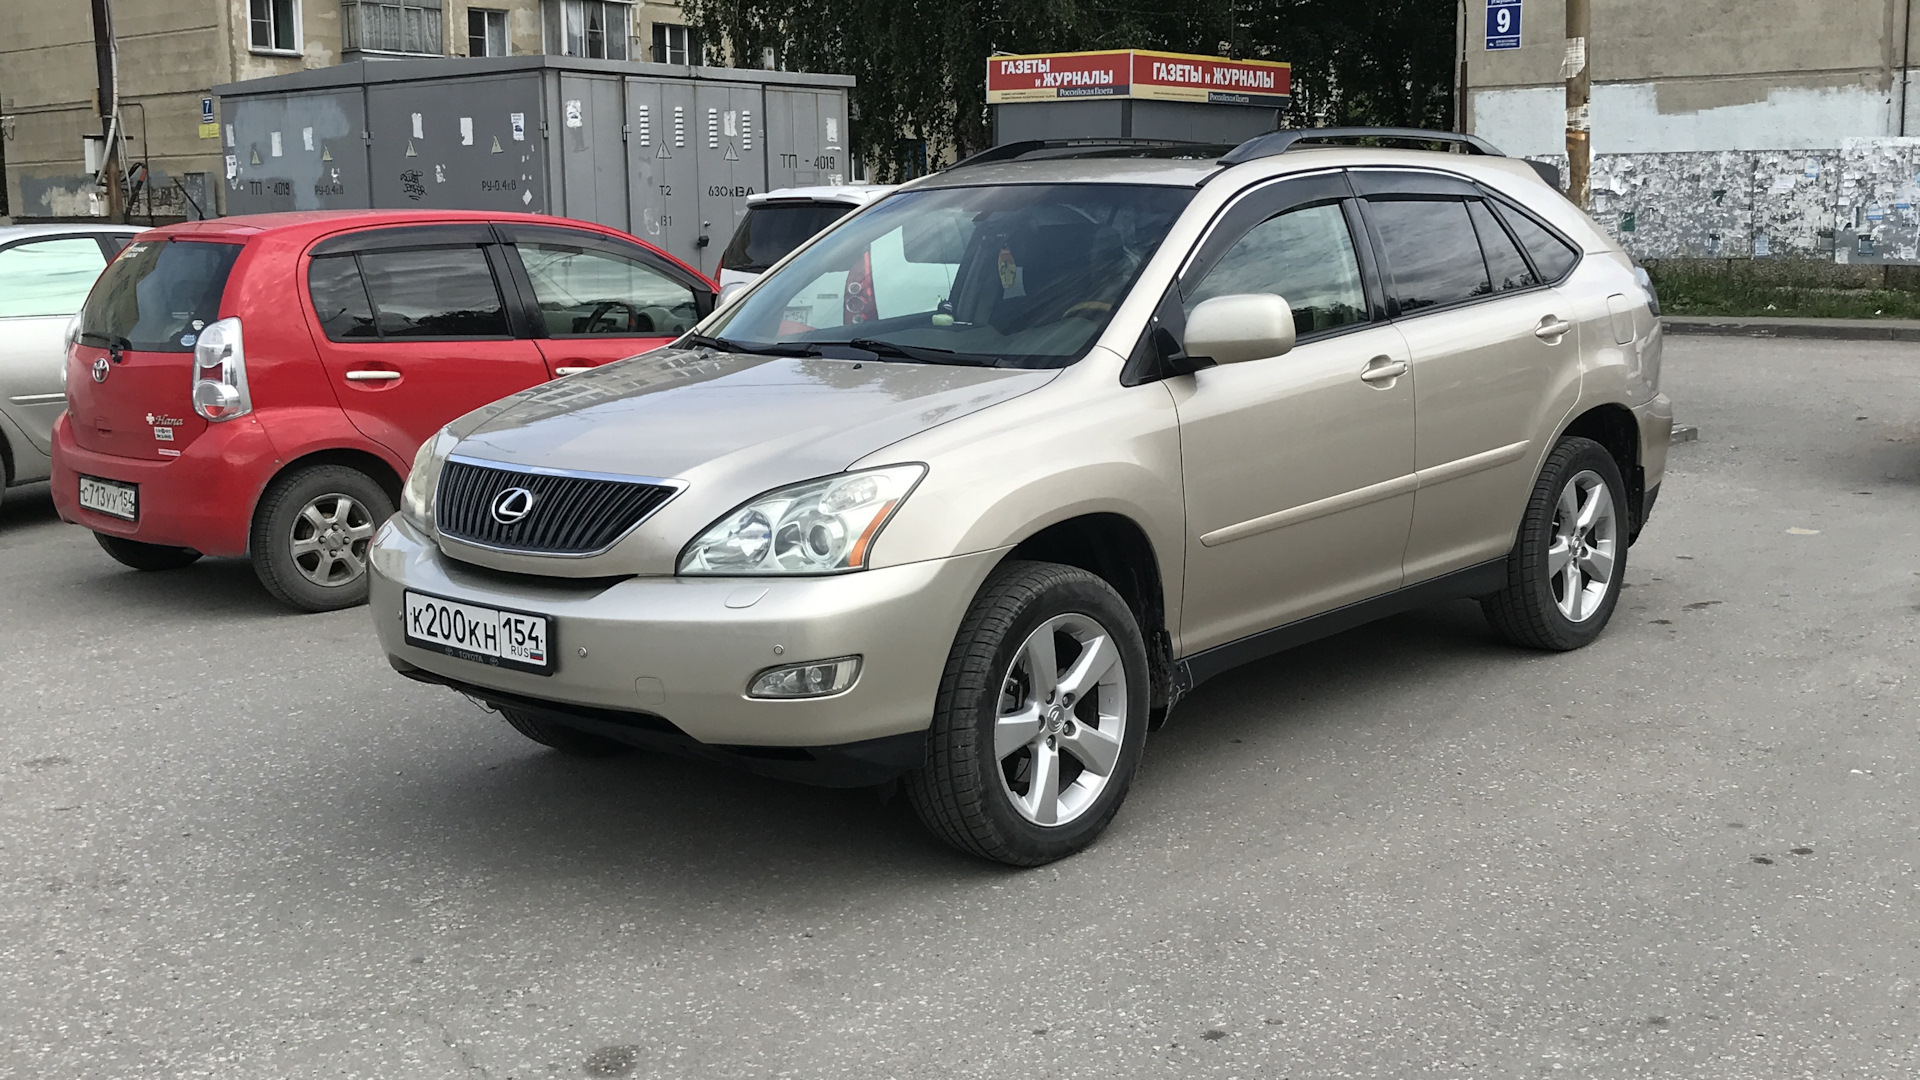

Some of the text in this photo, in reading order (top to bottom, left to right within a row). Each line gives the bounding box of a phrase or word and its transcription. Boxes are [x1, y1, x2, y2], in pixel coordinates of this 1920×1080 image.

[1496, 8, 1511, 33] 9
[1001, 59, 1050, 75] ГАЗЕТЫ
[1035, 70, 1113, 88] и ЖУРНАЛЫ
[1152, 62, 1275, 89] ГАЗЕТЫ и ЖУРНАЛЫ
[204, 100, 211, 114] 7
[780, 153, 798, 168] ТП
[814, 156, 835, 170] 4019
[273, 181, 290, 196] 4019
[156, 414, 183, 426] Hana
[119, 489, 135, 508] 154
[413, 603, 541, 652] К200КН 154
[458, 651, 484, 664] TOYOTA
[511, 645, 529, 659] RUS
